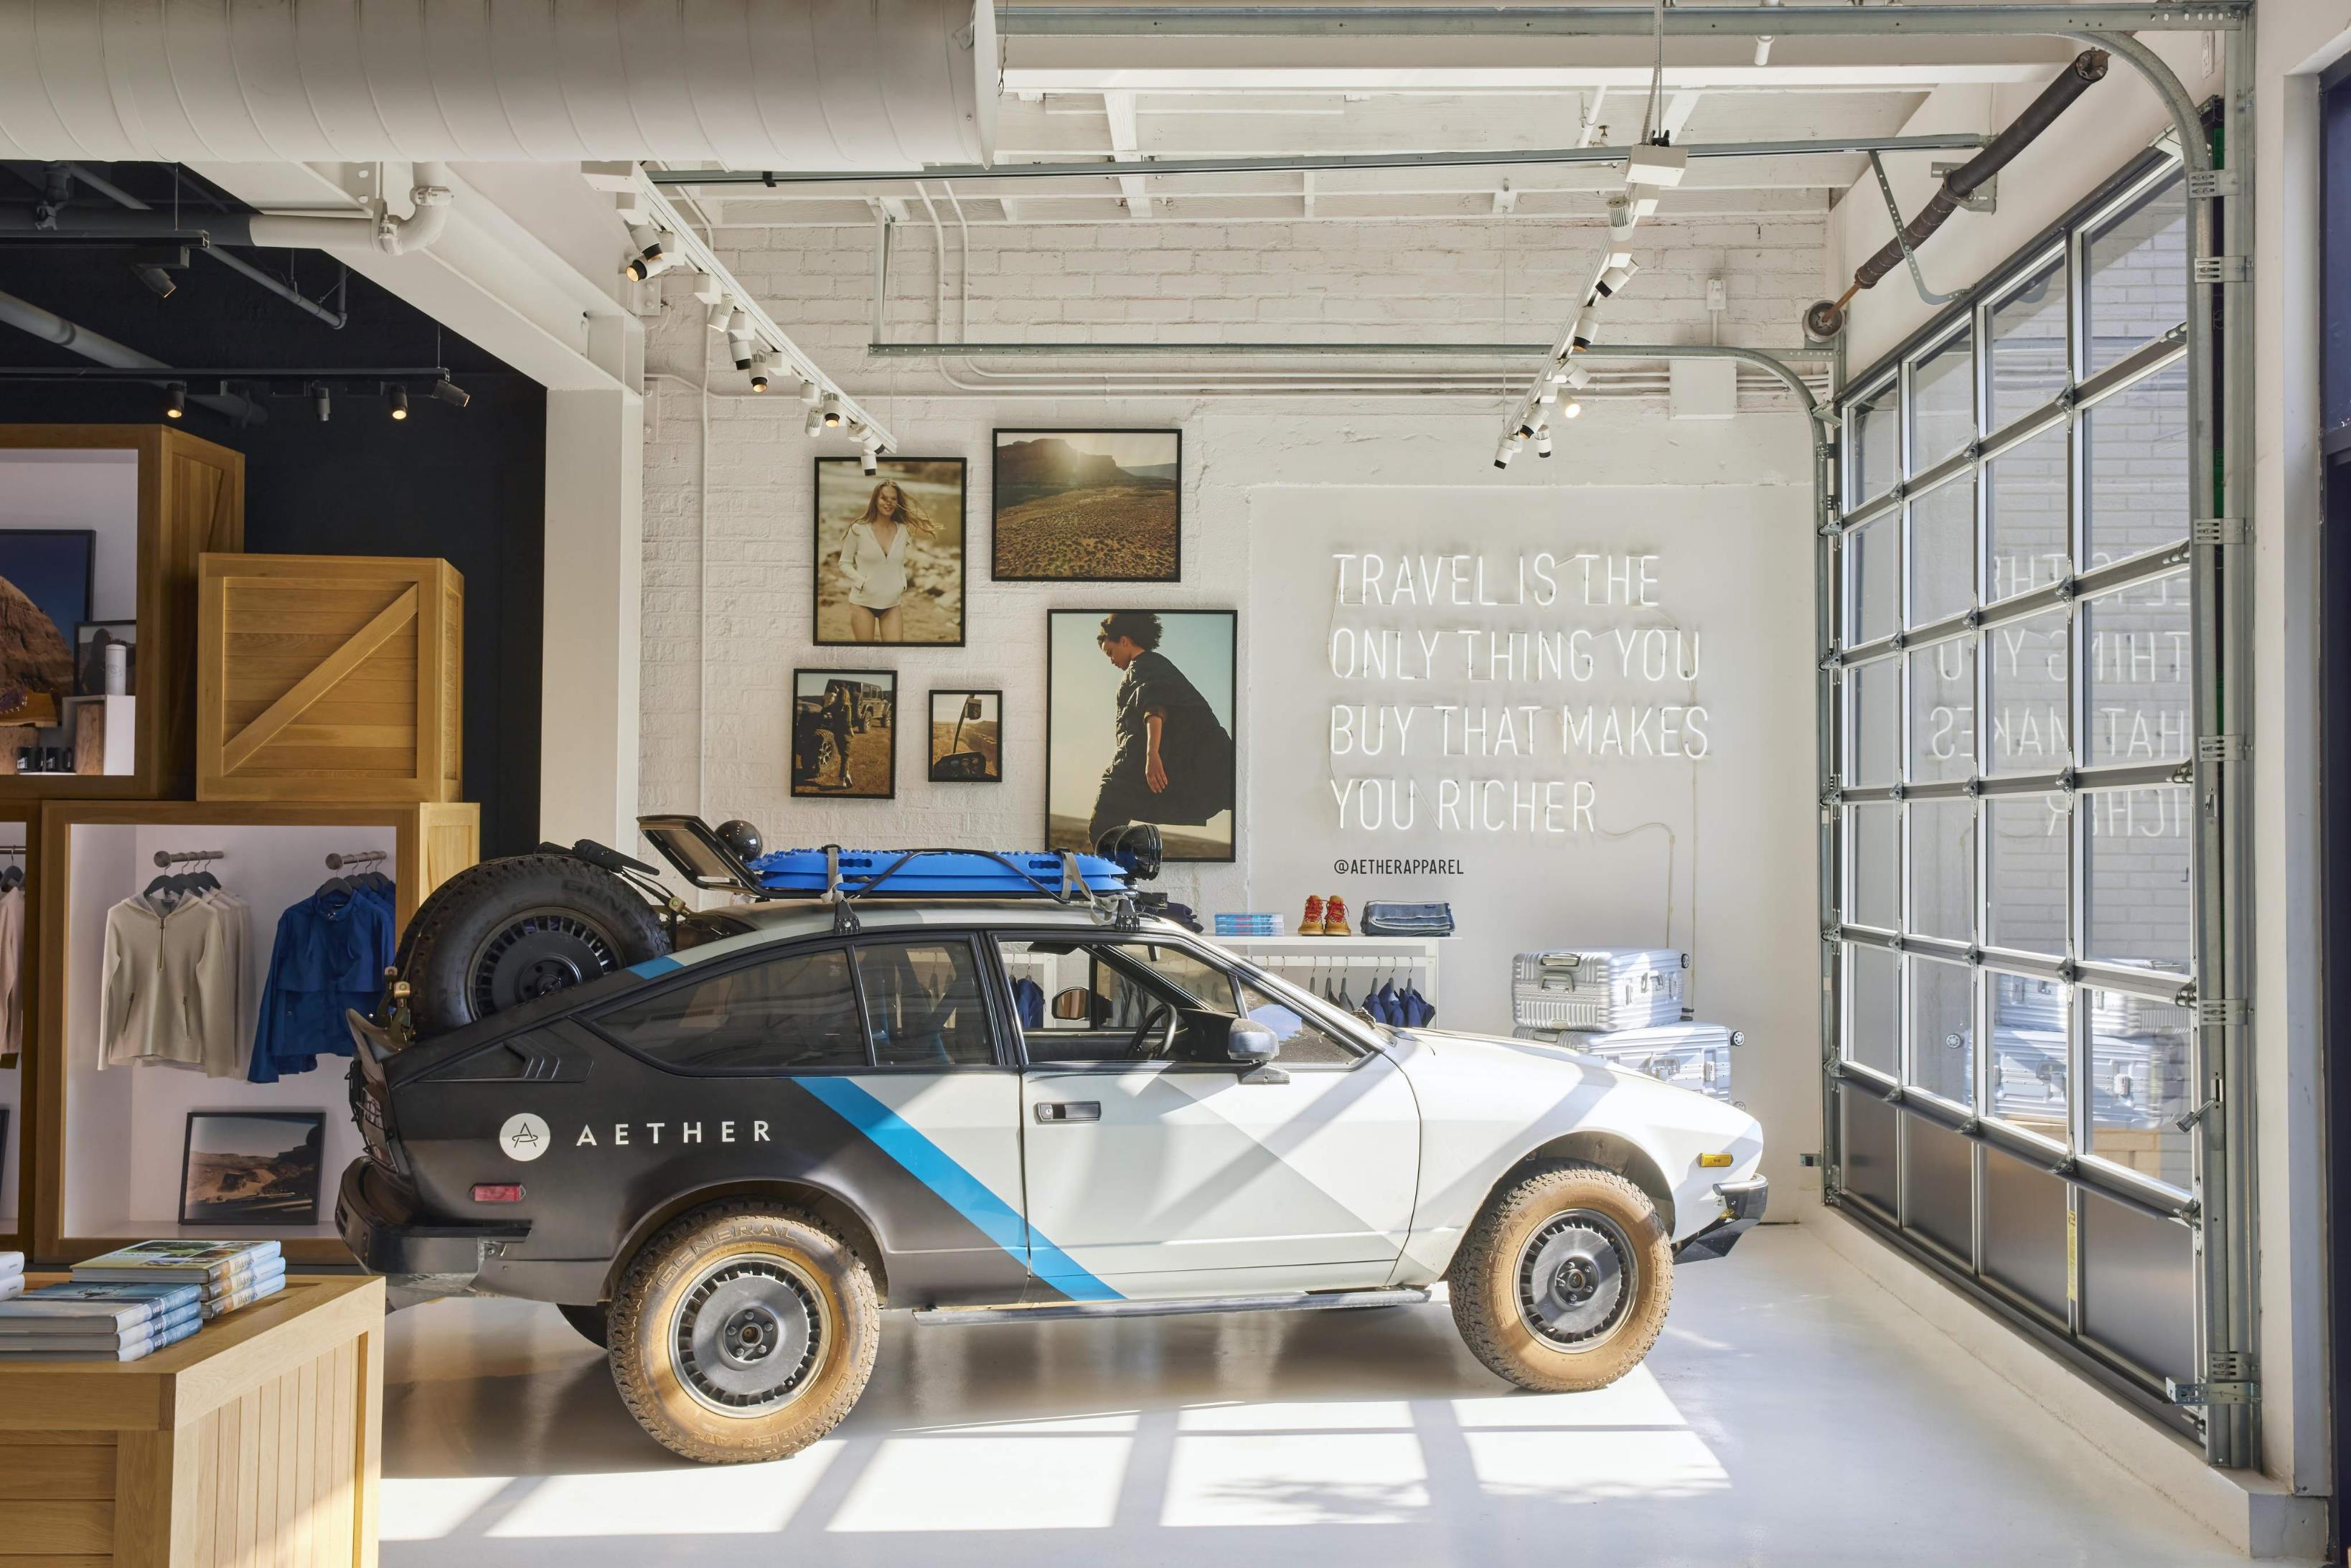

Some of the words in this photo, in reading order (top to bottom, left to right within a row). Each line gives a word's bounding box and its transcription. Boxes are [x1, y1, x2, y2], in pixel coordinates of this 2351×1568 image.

[1332, 554, 1498, 606] TRAVEL
[1519, 553, 1556, 606] IS
[1575, 554, 1660, 606] THE
[1332, 627, 1441, 680] ONLY
[1458, 629, 1593, 682] THING
[1615, 628, 1699, 682] YOU
[1331, 704, 1413, 756] BUY
[1433, 705, 1542, 756] THAT
[1562, 704, 1708, 759] MAKES
[1330, 778, 1414, 830] YOU
[1439, 779, 1595, 832] RICHER
[1334, 859, 1464, 875] @AETHERAPPAREL
[576, 1120, 771, 1146] AETHER
[656, 1223, 798, 1289] GENERAL
[740, 1371, 851, 1450] GRABBER
